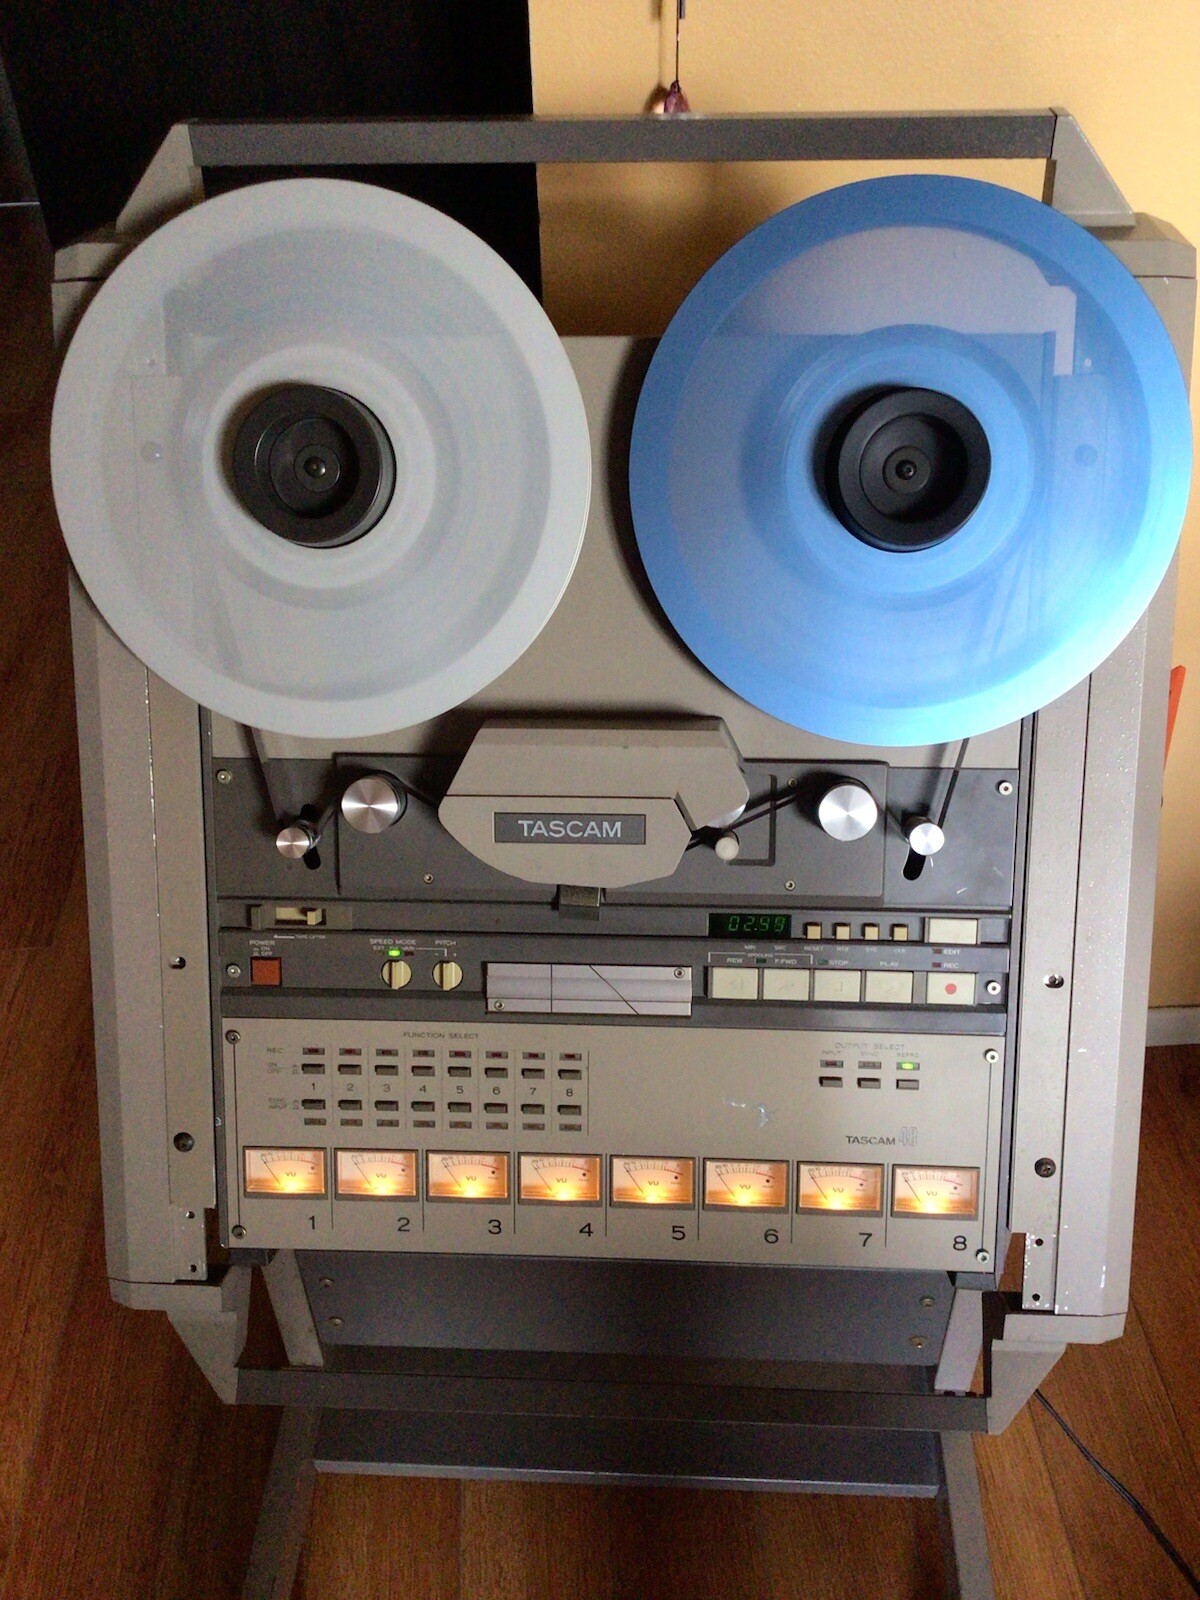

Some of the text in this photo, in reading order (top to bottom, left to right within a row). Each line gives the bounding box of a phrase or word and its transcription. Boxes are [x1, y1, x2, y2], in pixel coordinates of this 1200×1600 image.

[517, 819, 622, 838] TASCAM
[879, 960, 900, 968] PLAY
[403, 1031, 479, 1040] FUNCTION SELECT
[873, 1043, 905, 1051] SELECT
[346, 1082, 354, 1092] 2
[382, 1083, 391, 1093] 3
[419, 1085, 427, 1093] 4
[456, 1085, 464, 1094] 5
[492, 1086, 501, 1095] 6
[529, 1087, 537, 1096] 7
[565, 1088, 574, 1097] 8
[846, 1135, 896, 1146] TASCAM
[308, 1215, 316, 1230] 1
[397, 1217, 411, 1232] 2
[488, 1219, 502, 1235] 3
[578, 1222, 594, 1237] 4
[671, 1225, 686, 1241] 5
[763, 1228, 779, 1244] 6
[858, 1232, 873, 1247] 7
[952, 1235, 967, 1251] 8
